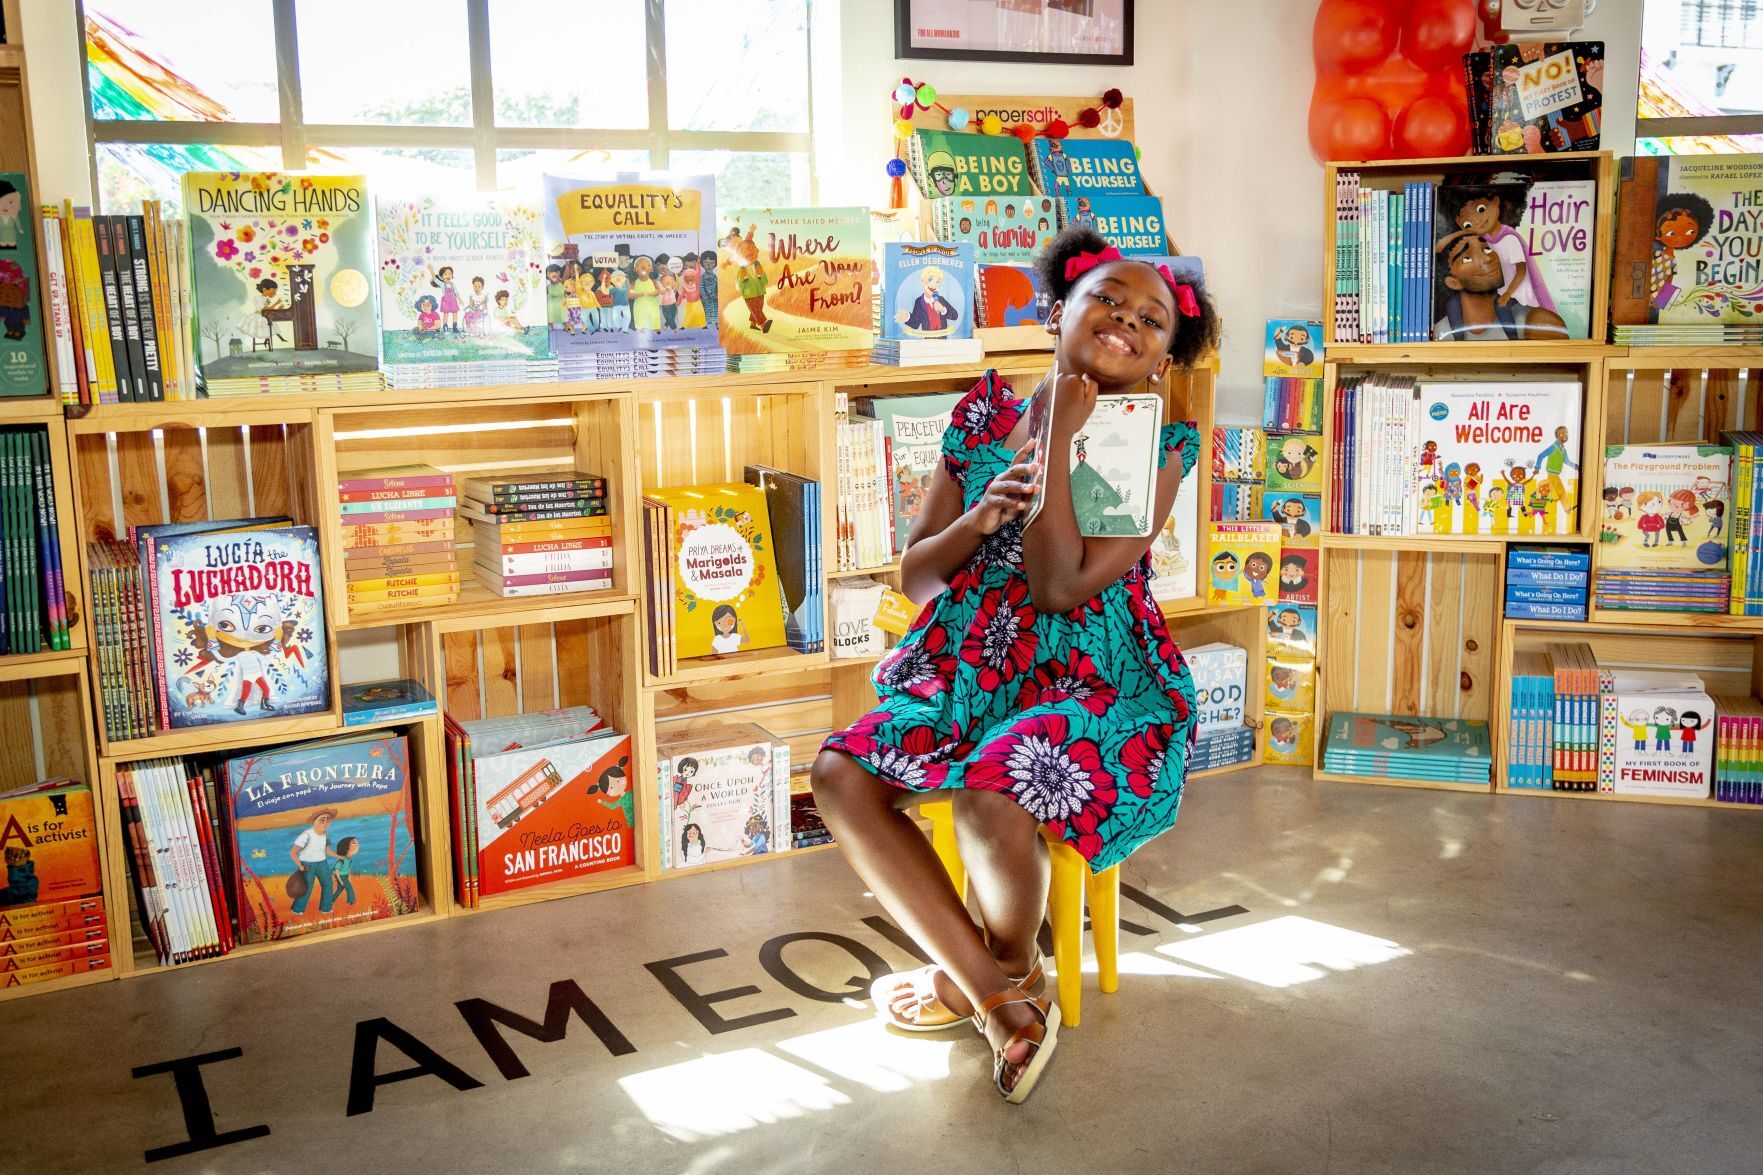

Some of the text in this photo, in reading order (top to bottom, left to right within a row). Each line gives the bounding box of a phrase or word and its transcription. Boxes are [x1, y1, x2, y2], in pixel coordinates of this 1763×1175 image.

[1522, 55, 1571, 91] NO!
[1526, 86, 1577, 113] PROTEST
[957, 156, 1023, 173] BEING
[1070, 158, 1134, 173] BEING
[960, 175, 1021, 192] A BOY
[1072, 176, 1137, 188] YOURSELF
[294, 188, 360, 212] HANDS
[580, 191, 683, 210] EQUALITY'S
[1732, 190, 1763, 208] THE
[1530, 192, 1589, 225] Hair
[421, 213, 502, 228] IT FEELS GOOD
[613, 211, 656, 226] CALL
[976, 218, 990, 228] being
[1098, 216, 1160, 234] BEING
[1718, 209, 1762, 234] DAY
[415, 232, 509, 250] TO BE YOURSELF
[978, 225, 1036, 249] a family
[768, 233, 840, 264] Where
[1712, 235, 1762, 261] YOU
[899, 257, 964, 269] ELLEN DEGENERES
[49, 272, 57, 286] GET
[104, 270, 114, 285] THE
[777, 260, 864, 289] Are You
[106, 285, 118, 308] HEART
[809, 282, 863, 314] From?
[52, 303, 62, 327] STAND
[109, 309, 119, 319] OF
[134, 258, 159, 371] STRONG IS THE NEW PRETTY
[56, 329, 62, 338] UP
[111, 326, 123, 340] BOY
[11, 352, 27, 363] 10
[1468, 401, 1531, 421] All Are
[1455, 423, 1543, 444] Welcome
[894, 452, 907, 466] for
[1630, 463, 1680, 471] Playground
[384, 479, 404, 488] Selena
[372, 490, 426, 499] LUCHA LIBRE
[384, 512, 404, 520] Selena
[205, 538, 289, 568] LUCÍA the
[534, 543, 559, 551] LUCHA
[383, 556, 409, 566] Zapata
[545, 552, 571, 561] FRIDA
[686, 554, 747, 569] Marigolds
[385, 567, 412, 576] Zapata
[545, 564, 571, 572] FRIDA
[691, 566, 743, 581] & Masala
[1531, 572, 1552, 580] What
[171, 560, 315, 608] LUCHADORA
[387, 579, 417, 588] RITCHIE
[547, 574, 566, 583] Selena
[388, 589, 418, 598] RITCHIE
[833, 618, 869, 637] LOVE
[834, 634, 870, 646] BLOCKS
[1224, 653, 1244, 664] DO
[1215, 669, 1243, 681] SAY
[245, 763, 397, 801] LA FRONTERA
[694, 776, 754, 792] ONCE UPON
[1620, 768, 1703, 784] FEMINISM
[257, 800, 265, 808] El
[265, 797, 281, 806] viaje
[295, 788, 312, 797] papá
[318, 784, 328, 792] My
[329, 782, 356, 790] Journey
[372, 782, 388, 790] Papa
[710, 787, 748, 799] WORLD
[706, 799, 741, 808] COLLECTION
[0, 814, 64, 850] A is for
[35, 828, 88, 845] activist
[520, 819, 623, 850] Neela Goes to
[504, 833, 621, 875] SAN FRANCISCO
[580, 859, 605, 868] COUNTING
[0, 914, 12, 926] A
[31, 909, 55, 917] activist
[3, 928, 16, 942] A
[35, 923, 59, 931] activist
[130, 880, 1252, 1164] I AM EQL
